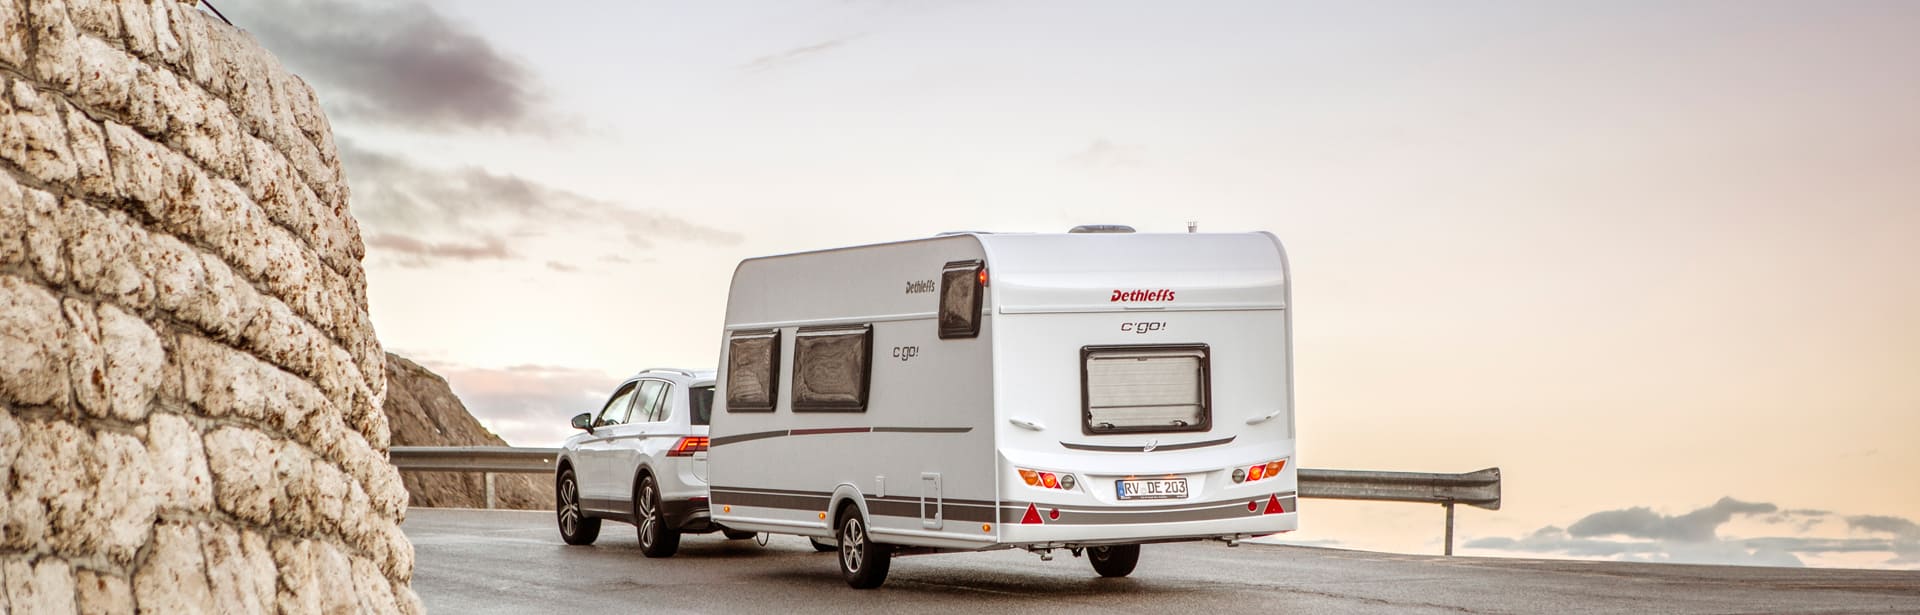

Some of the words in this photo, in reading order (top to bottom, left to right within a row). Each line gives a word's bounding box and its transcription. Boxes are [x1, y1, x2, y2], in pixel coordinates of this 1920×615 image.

[905, 280, 935, 294] Dethleffs
[1111, 289, 1175, 302] Dethleffs
[1124, 482, 1139, 495] RV
[1147, 481, 1162, 494] DE
[1164, 481, 1186, 494] 203
